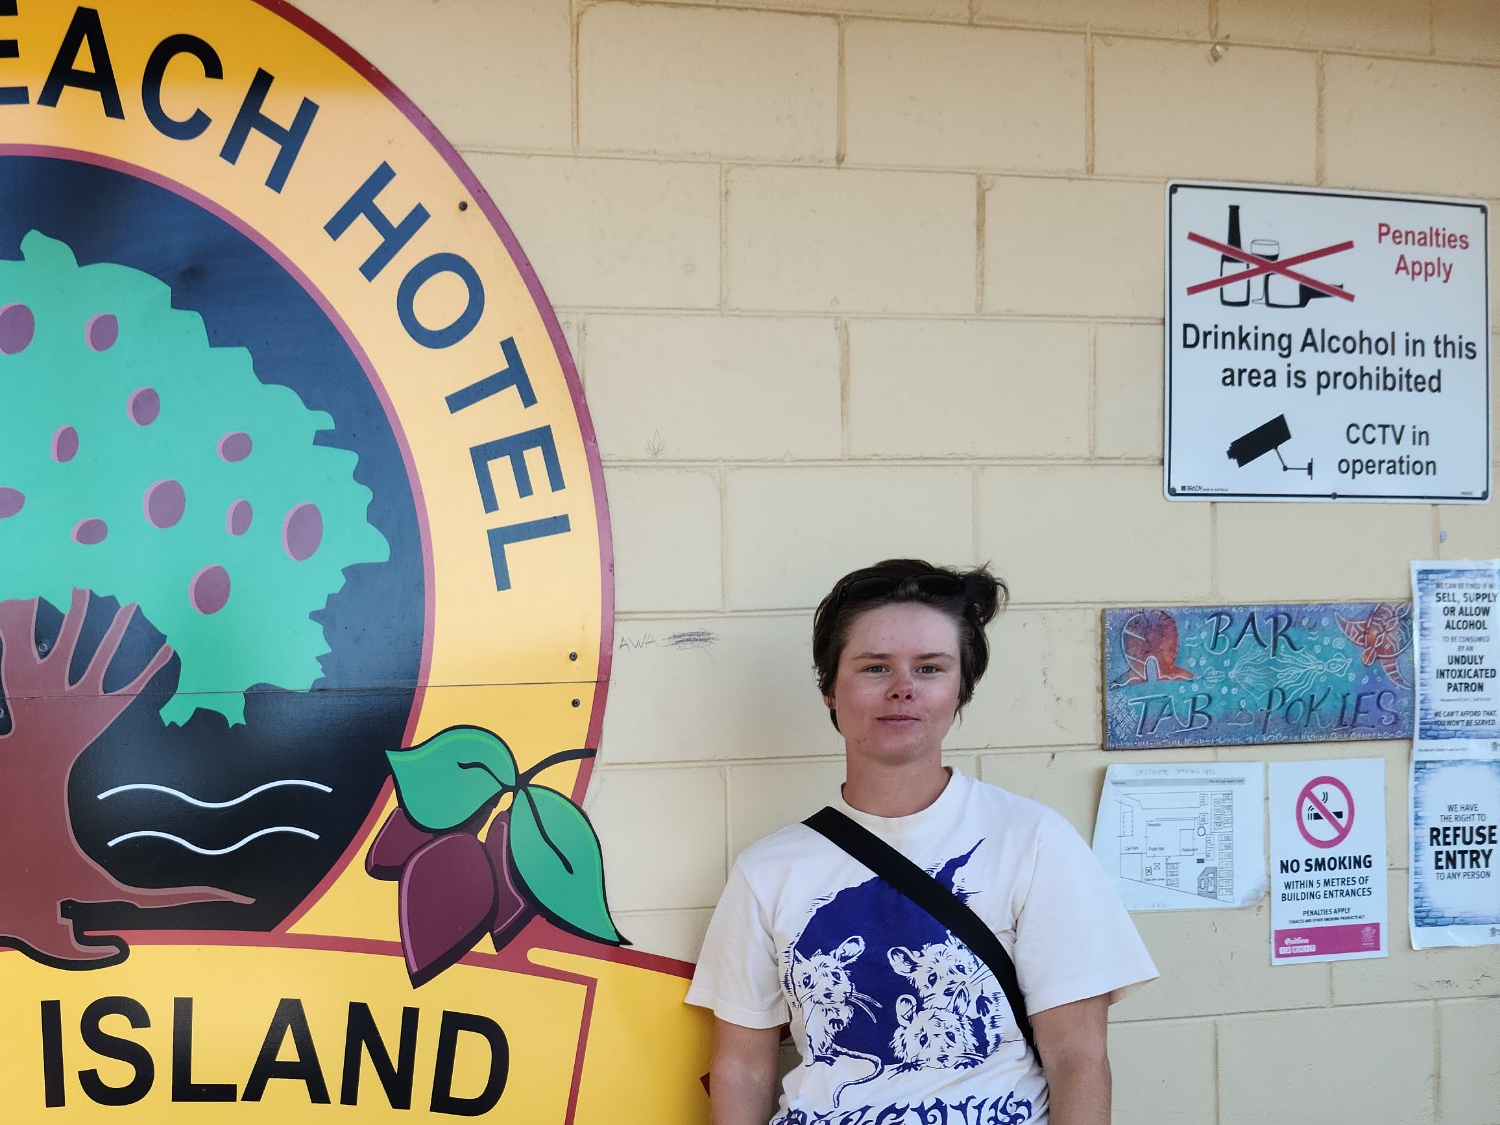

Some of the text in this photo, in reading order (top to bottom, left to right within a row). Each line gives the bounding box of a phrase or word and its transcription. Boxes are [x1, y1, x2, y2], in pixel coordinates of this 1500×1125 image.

[1377, 223, 1470, 250] Penalties
[1395, 255, 1454, 283] Apply
[1182, 324, 1478, 360] Drinking Alcohol in this
[323, 161, 571, 592] HOTEL
[1221, 364, 1442, 395] area is prohibited
[1346, 423, 1430, 446] CCTV in
[1338, 455, 1437, 480] operation
[1436, 592, 1499, 604] SELL, SUPPLY
[1443, 606, 1491, 617] OR ALLOW
[1205, 611, 1304, 659] BAR
[1445, 620, 1488, 630] ALCOHOL
[1447, 655, 1485, 666] UNDULY
[1436, 668, 1496, 679] INTOXICATED
[1447, 682, 1484, 692] PATRON
[1128, 693, 1213, 737] TAB
[1258, 687, 1401, 735] POKIES
[1440, 813, 1487, 822] THE RIGHT TO
[1447, 804, 1479, 812] WE HAVE
[1429, 825, 1498, 846] REFUSE
[1280, 854, 1373, 874] NO SMOKING
[1434, 848, 1494, 870] ENTRY
[1284, 876, 1370, 890] WITHIN 5 METRES OF
[1436, 871, 1491, 880] TO ANY PERSON
[1281, 887, 1373, 902] BUILDING ENTRANCES
[1302, 907, 1351, 917] PENALTIES APPLY
[41, 996, 511, 1119] ISLAND
